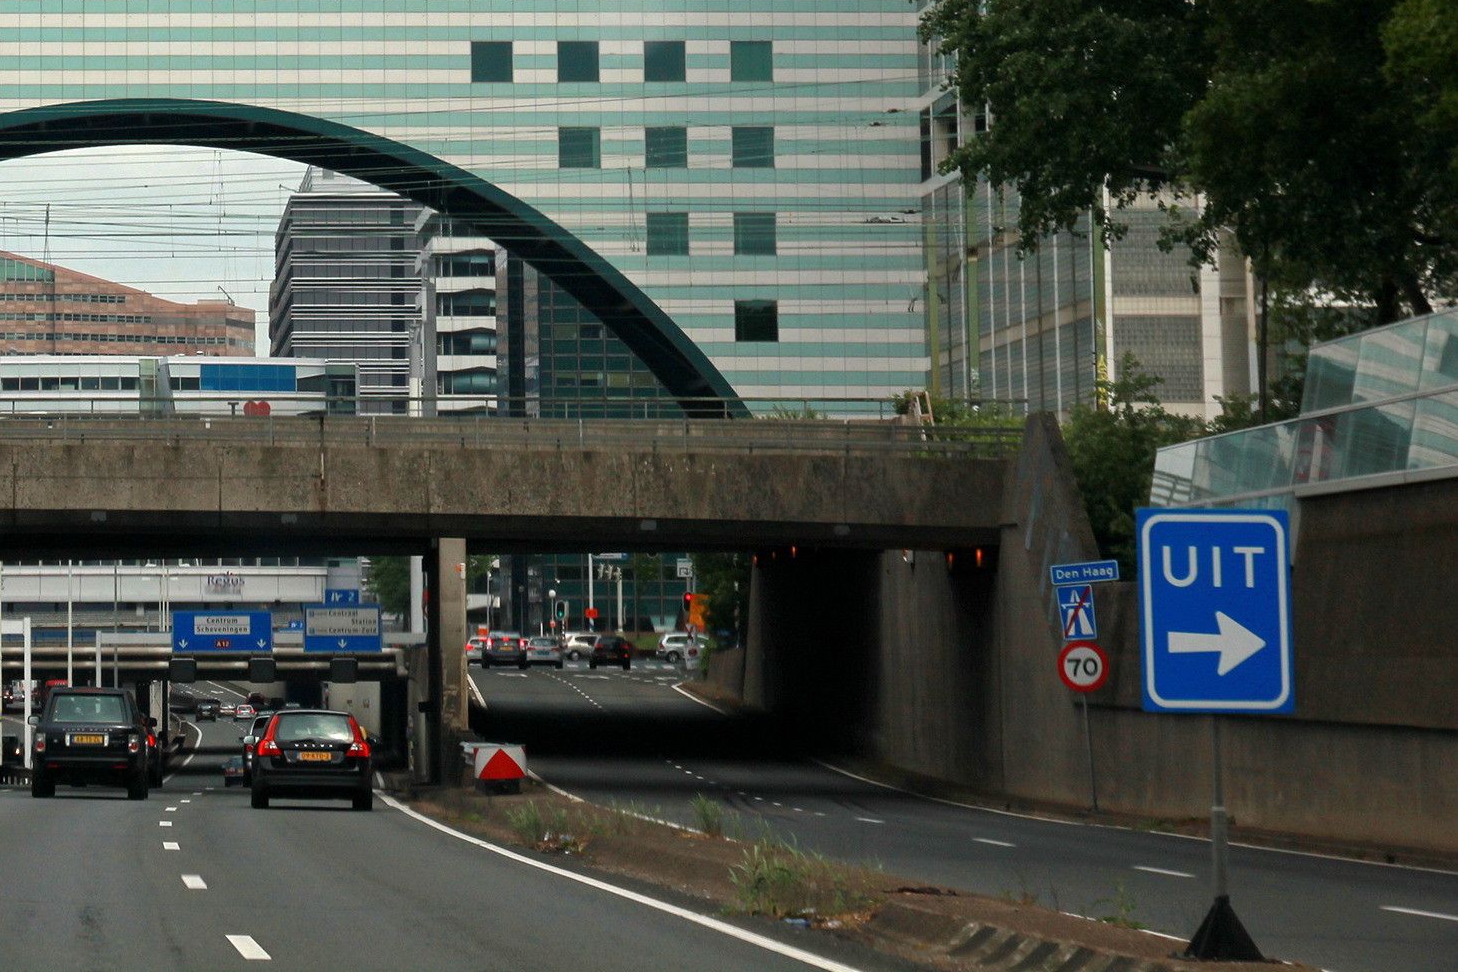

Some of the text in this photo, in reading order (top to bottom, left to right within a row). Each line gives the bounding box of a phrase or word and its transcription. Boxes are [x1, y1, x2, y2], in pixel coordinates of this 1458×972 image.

[1055, 566, 1114, 580] Den Haag
[1162, 545, 1265, 588] UIT
[207, 574, 245, 588] Regus
[206, 617, 239, 625] Centrum
[196, 625, 249, 634] Scheveningen
[1067, 657, 1099, 677] 70
